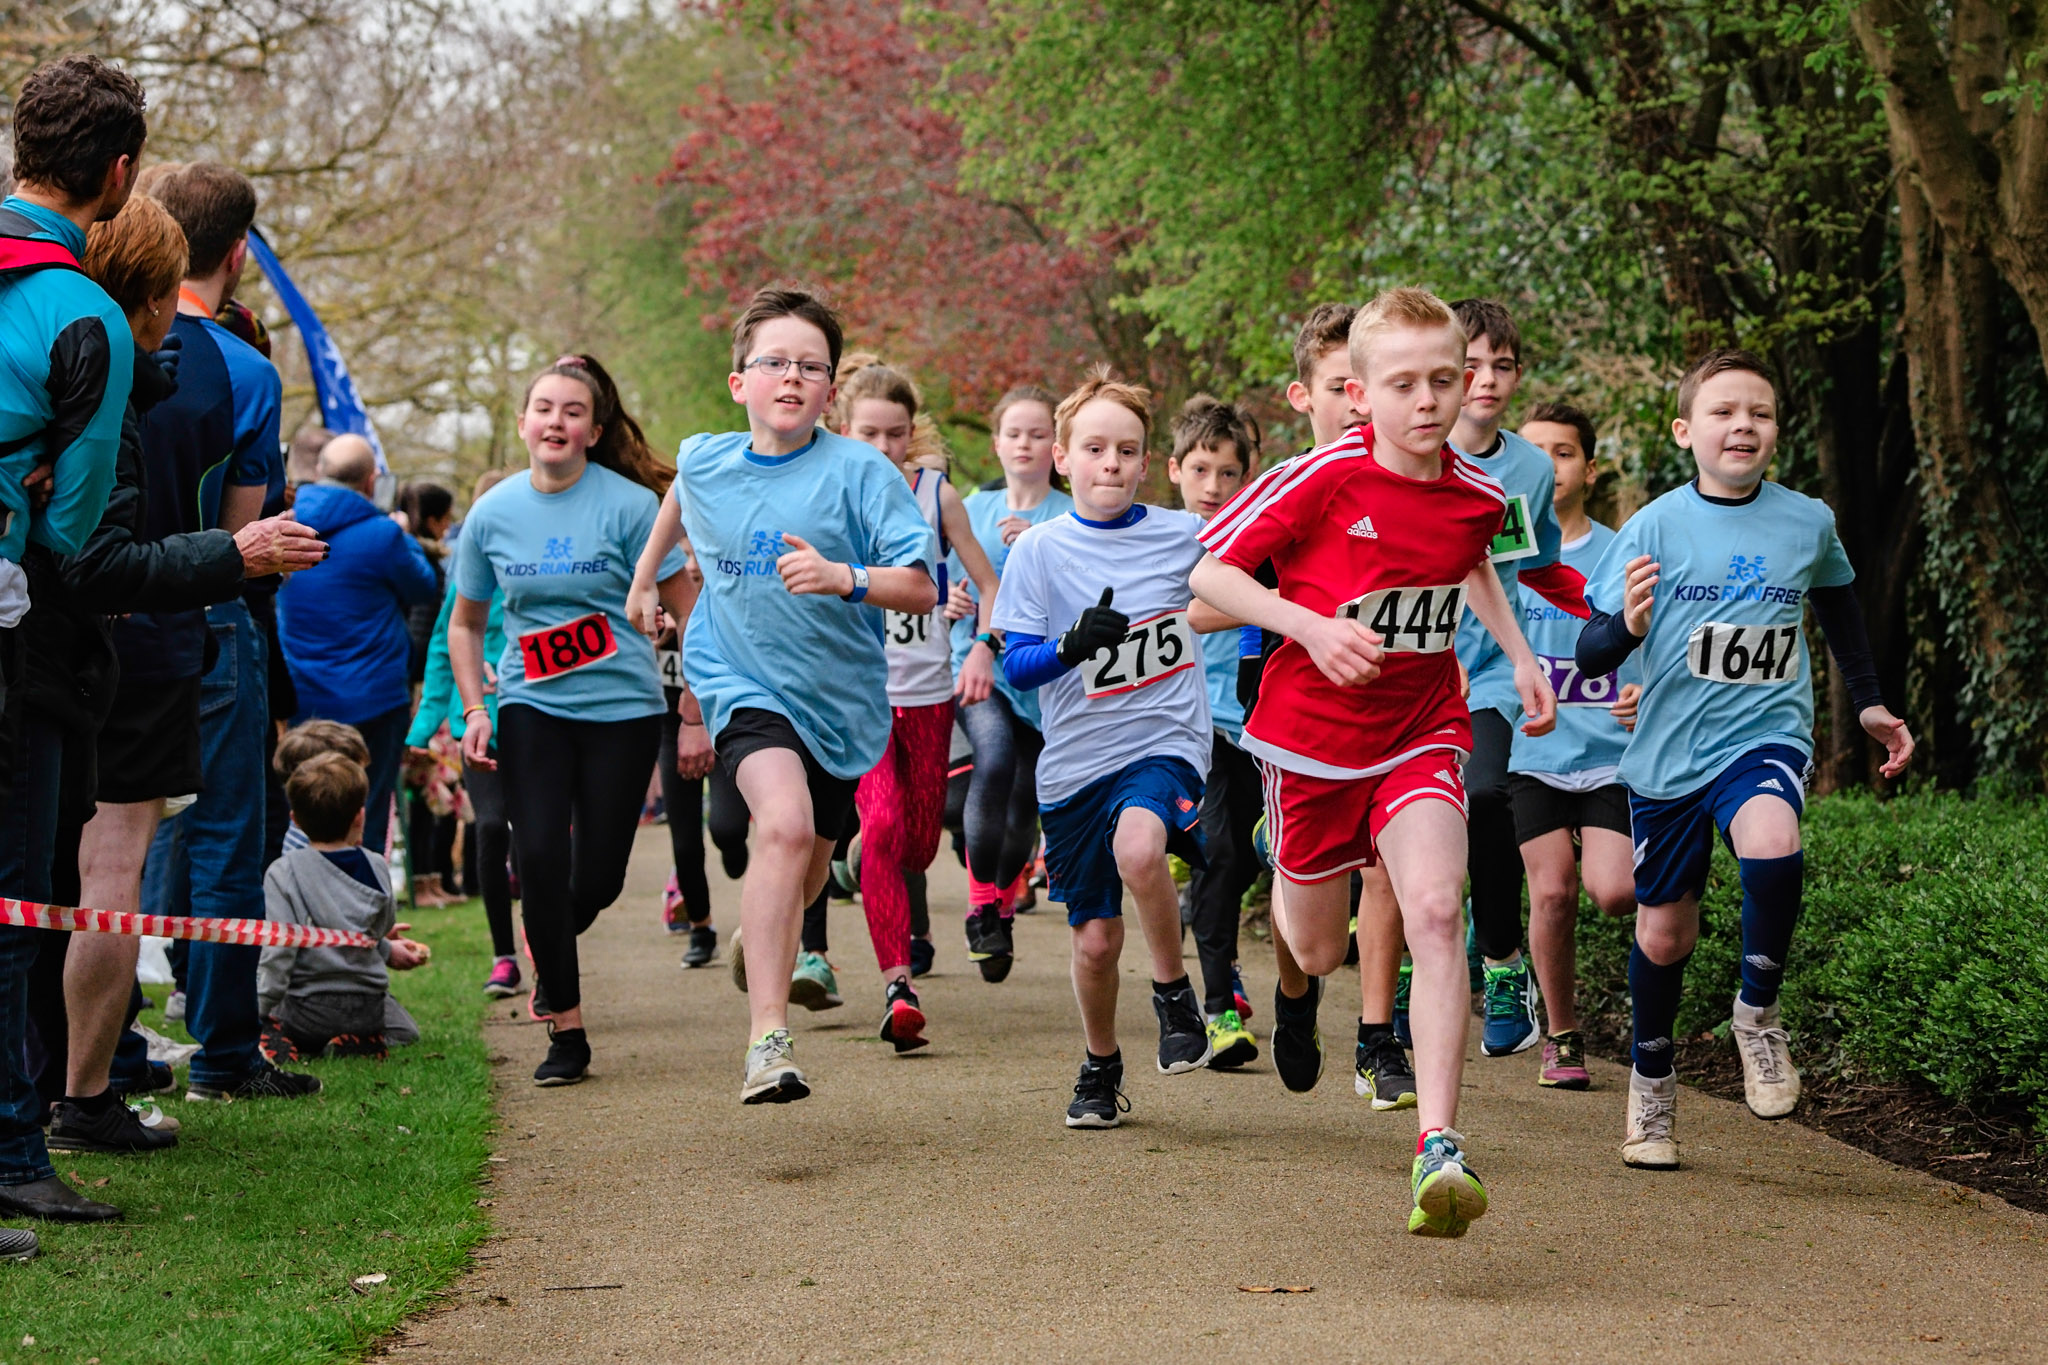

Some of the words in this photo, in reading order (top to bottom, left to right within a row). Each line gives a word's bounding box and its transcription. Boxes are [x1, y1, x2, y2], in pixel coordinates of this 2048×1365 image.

[1346, 527, 1379, 539] adidas
[505, 562, 537, 576] KIDS
[1674, 585, 1719, 601] KIDS
[1346, 587, 1461, 649] 444
[528, 618, 607, 674] 180
[1088, 617, 1183, 689] 275
[1699, 625, 1798, 680] 1647
